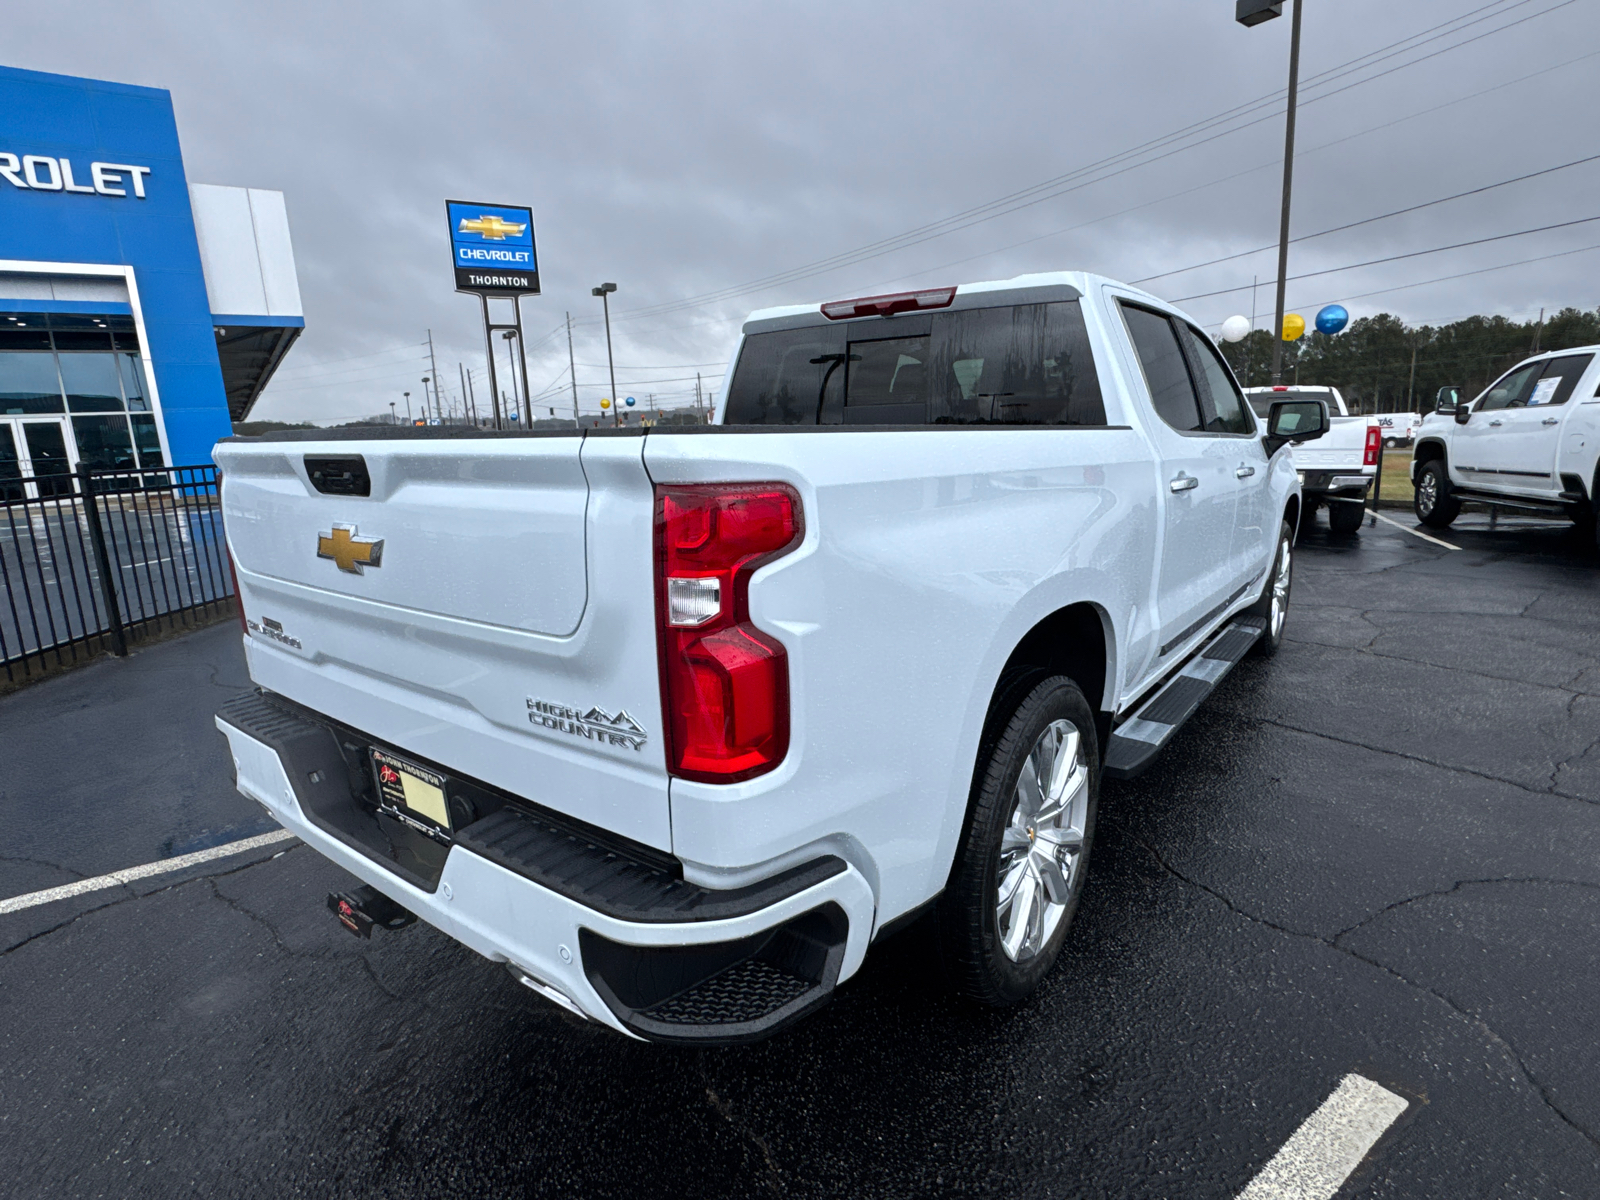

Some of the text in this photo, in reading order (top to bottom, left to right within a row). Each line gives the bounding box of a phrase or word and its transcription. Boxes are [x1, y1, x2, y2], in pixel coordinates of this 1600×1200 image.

[460, 248, 530, 262] CHEVROLET
[469, 275, 528, 287] THORNTON
[526, 695, 583, 722] HIGH
[528, 711, 647, 751] COUNTRY
